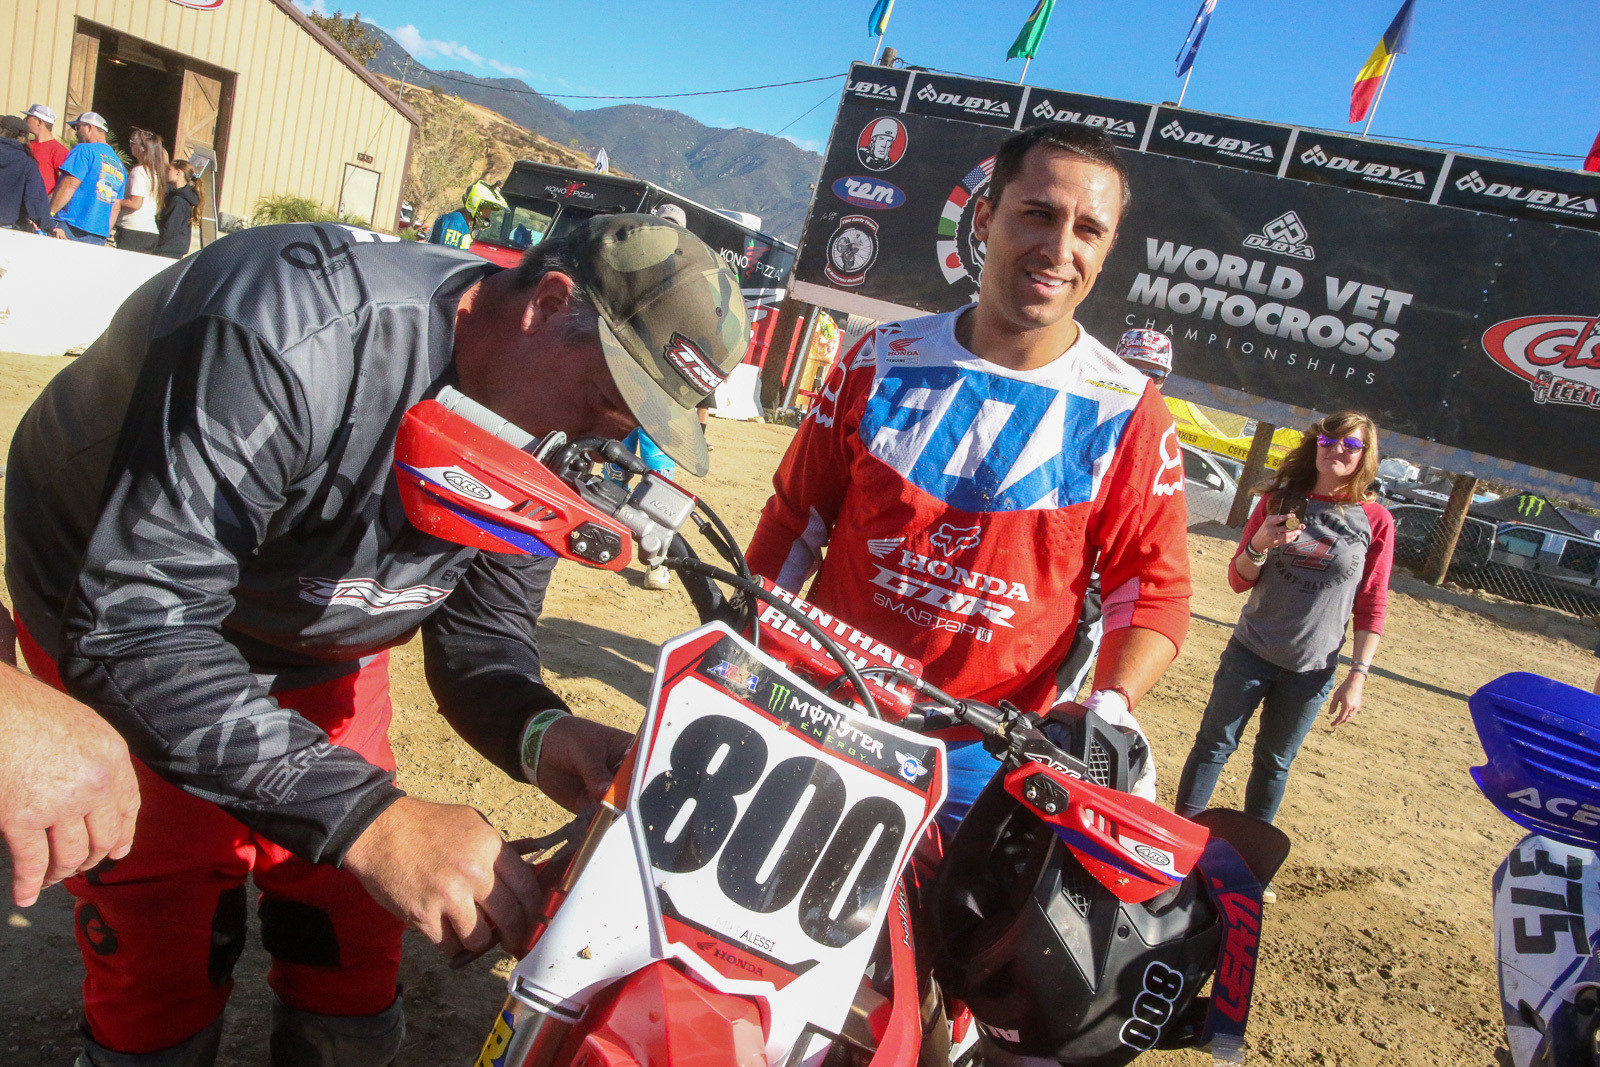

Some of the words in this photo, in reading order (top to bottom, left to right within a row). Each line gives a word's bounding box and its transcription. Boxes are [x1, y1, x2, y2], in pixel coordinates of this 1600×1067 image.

[935, 93, 1011, 114] DUBYA
[1053, 109, 1136, 134] DUBYA
[1183, 130, 1274, 159] DUBYA
[1216, 149, 1272, 163] dubyausa.com
[1325, 156, 1426, 185] DUBYA
[1362, 175, 1424, 190] dubyausa.com
[544, 185, 567, 195] KONO
[572, 190, 597, 200] PIZZA
[1483, 183, 1599, 213] DUBYA
[1525, 203, 1596, 218] dubyausa.com
[445, 228, 463, 243] FLY
[1244, 235, 1313, 258] DUBYA
[720, 247, 749, 269] KONO
[755, 262, 782, 281] PIZZA
[1146, 237, 1304, 300] WORLD
[1325, 275, 1414, 325] VET
[1126, 272, 1400, 362] MOTOCROSS
[1125, 313, 1376, 385] CHAMPIONSHIPS
[899, 549, 1030, 603] HONDA
[769, 585, 910, 672] RENTHAL
[790, 697, 885, 760] MONSTER
[904, 761, 918, 774] FIM
[638, 714, 906, 948] 800
[1509, 847, 1591, 957] 375
[739, 929, 776, 953] ALESSI
[713, 948, 764, 978] HONDA
[1119, 960, 1184, 1051] 800
